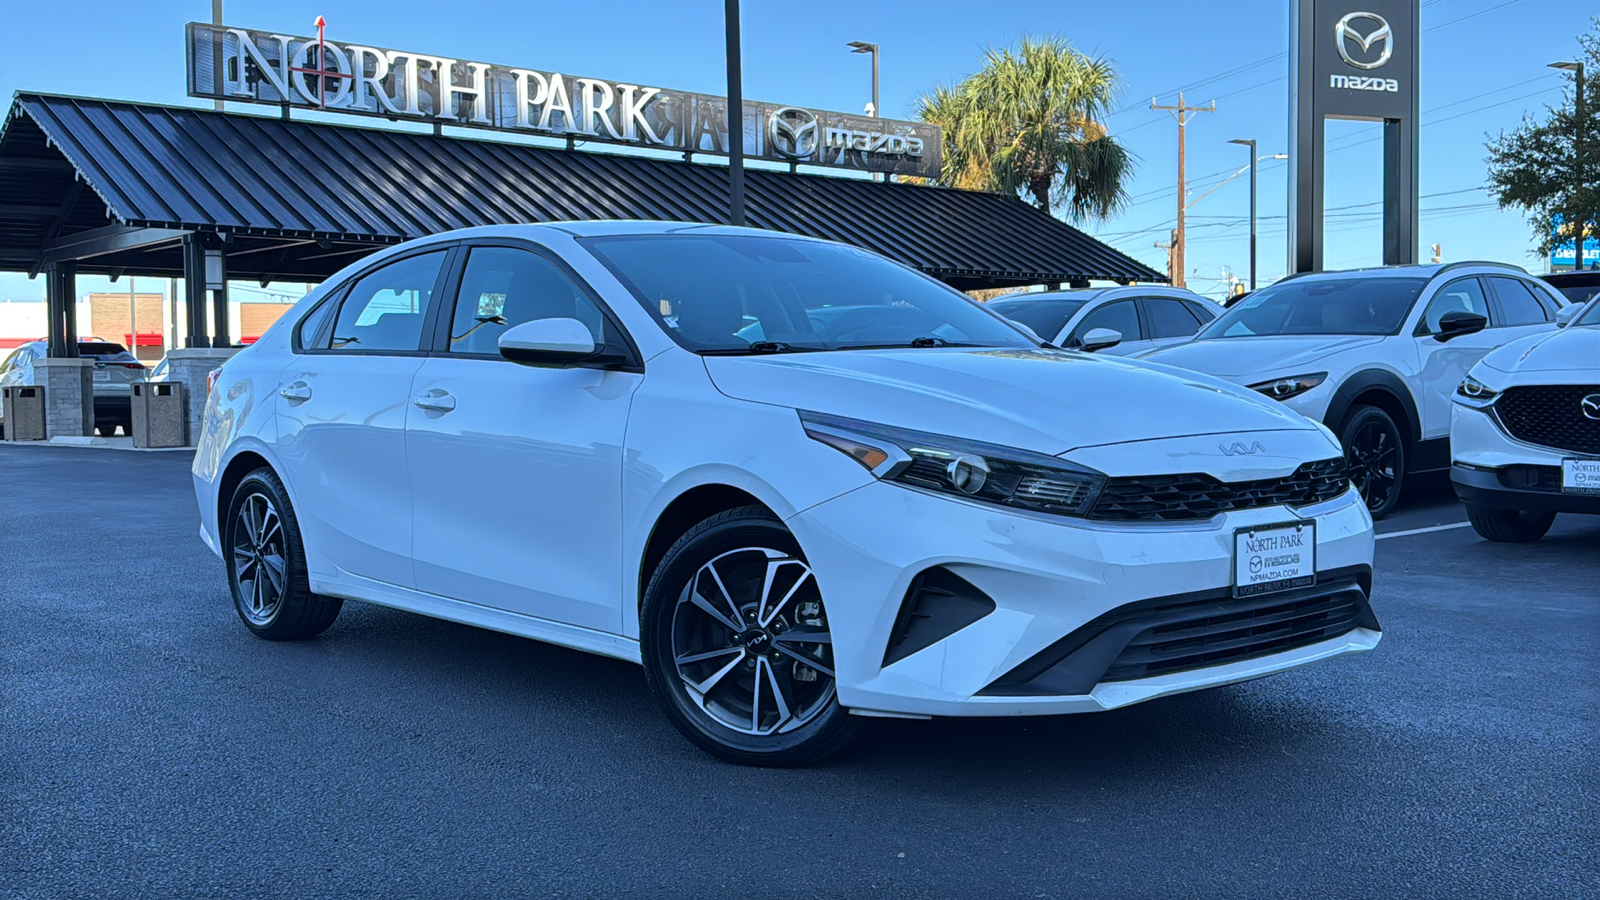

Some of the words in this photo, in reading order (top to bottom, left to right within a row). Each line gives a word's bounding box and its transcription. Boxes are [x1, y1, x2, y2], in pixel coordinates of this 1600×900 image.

[226, 28, 492, 125] NORTH
[509, 68, 664, 145] PARK
[1330, 74, 1398, 92] mazda
[823, 127, 925, 158] mazda
[1246, 537, 1277, 553] NORTH
[1280, 534, 1303, 548] PARK
